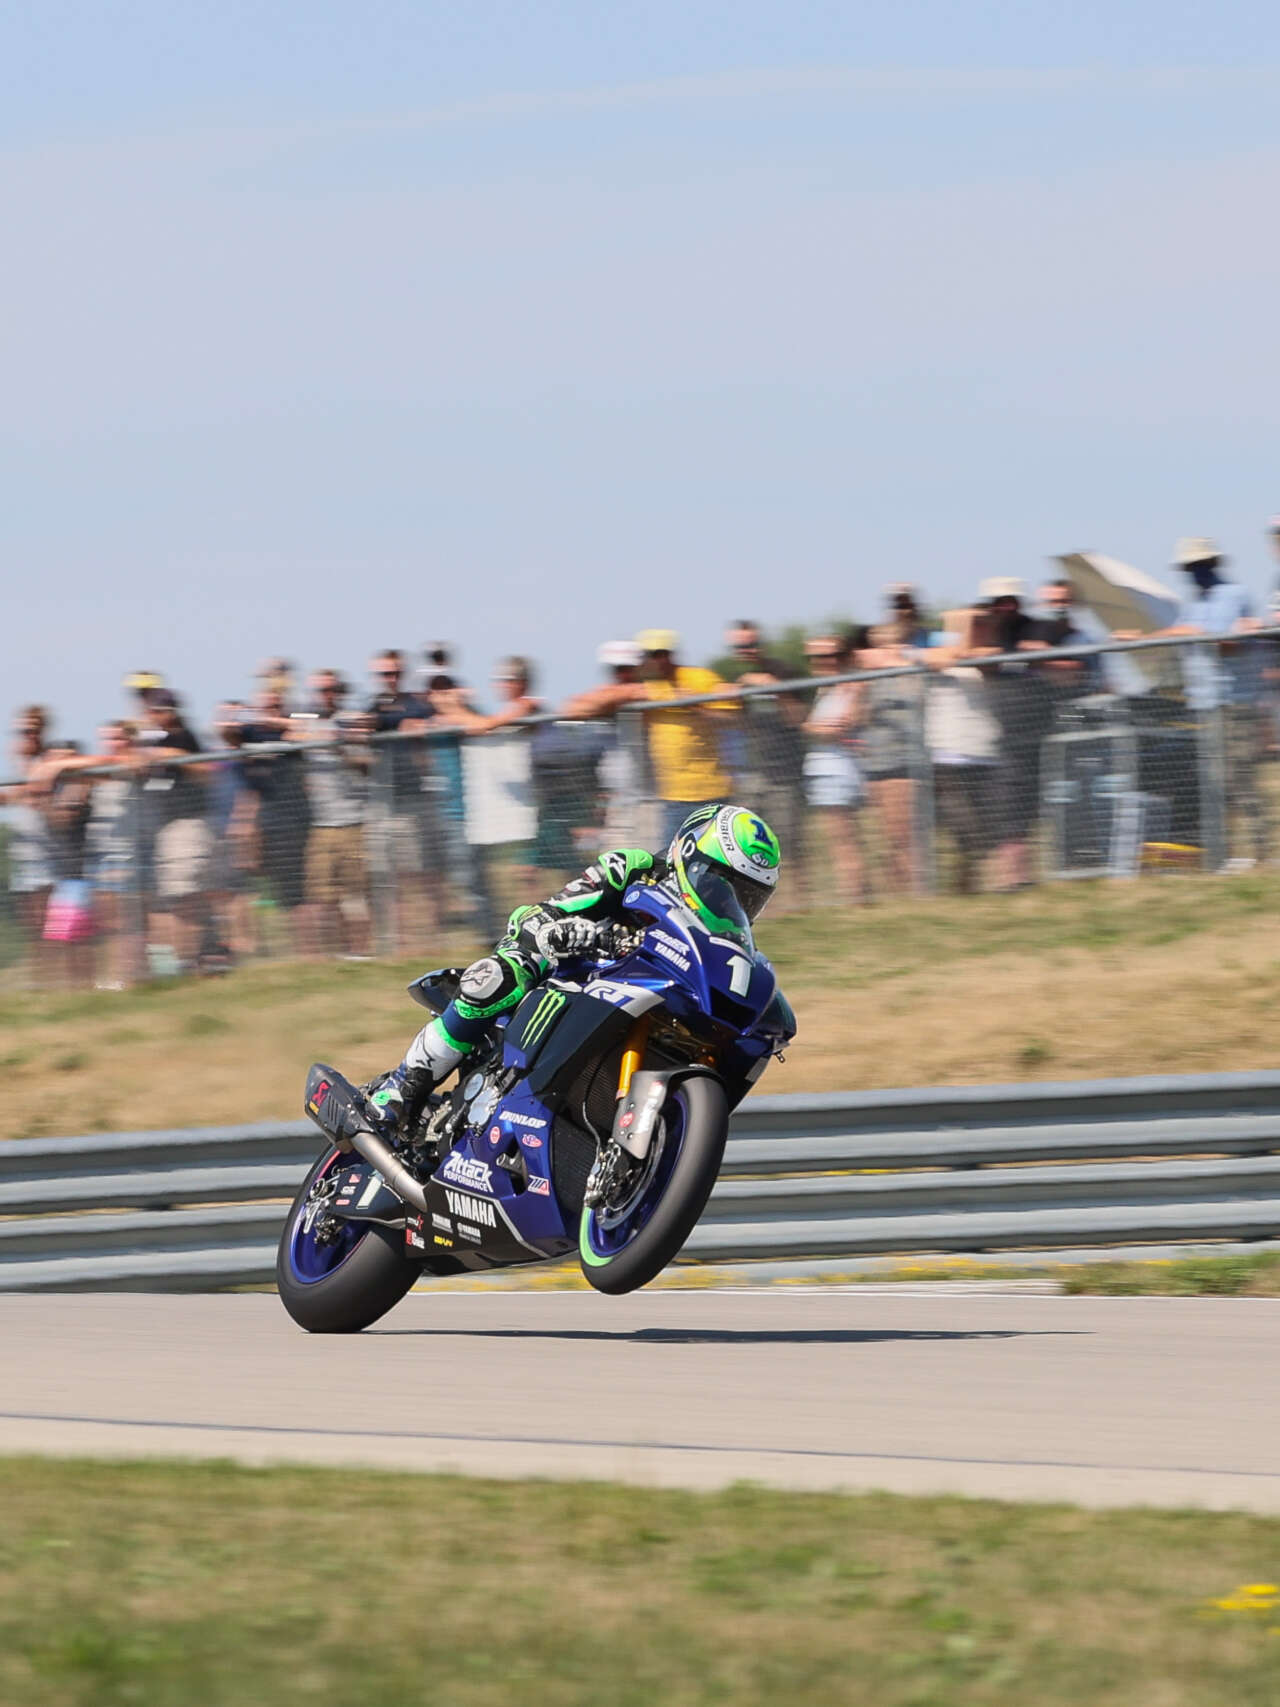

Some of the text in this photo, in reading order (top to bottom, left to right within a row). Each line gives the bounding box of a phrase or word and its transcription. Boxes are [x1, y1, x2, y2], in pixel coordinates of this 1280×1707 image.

[654, 942, 691, 972] YAMAHA
[726, 955, 752, 998] 1
[499, 1111, 547, 1129] DUNLOP
[356, 1169, 385, 1210] 1
[443, 1170, 489, 1192] PERFORMANCE
[444, 1150, 494, 1193] Attack
[445, 1189, 497, 1228] YAMAHA
